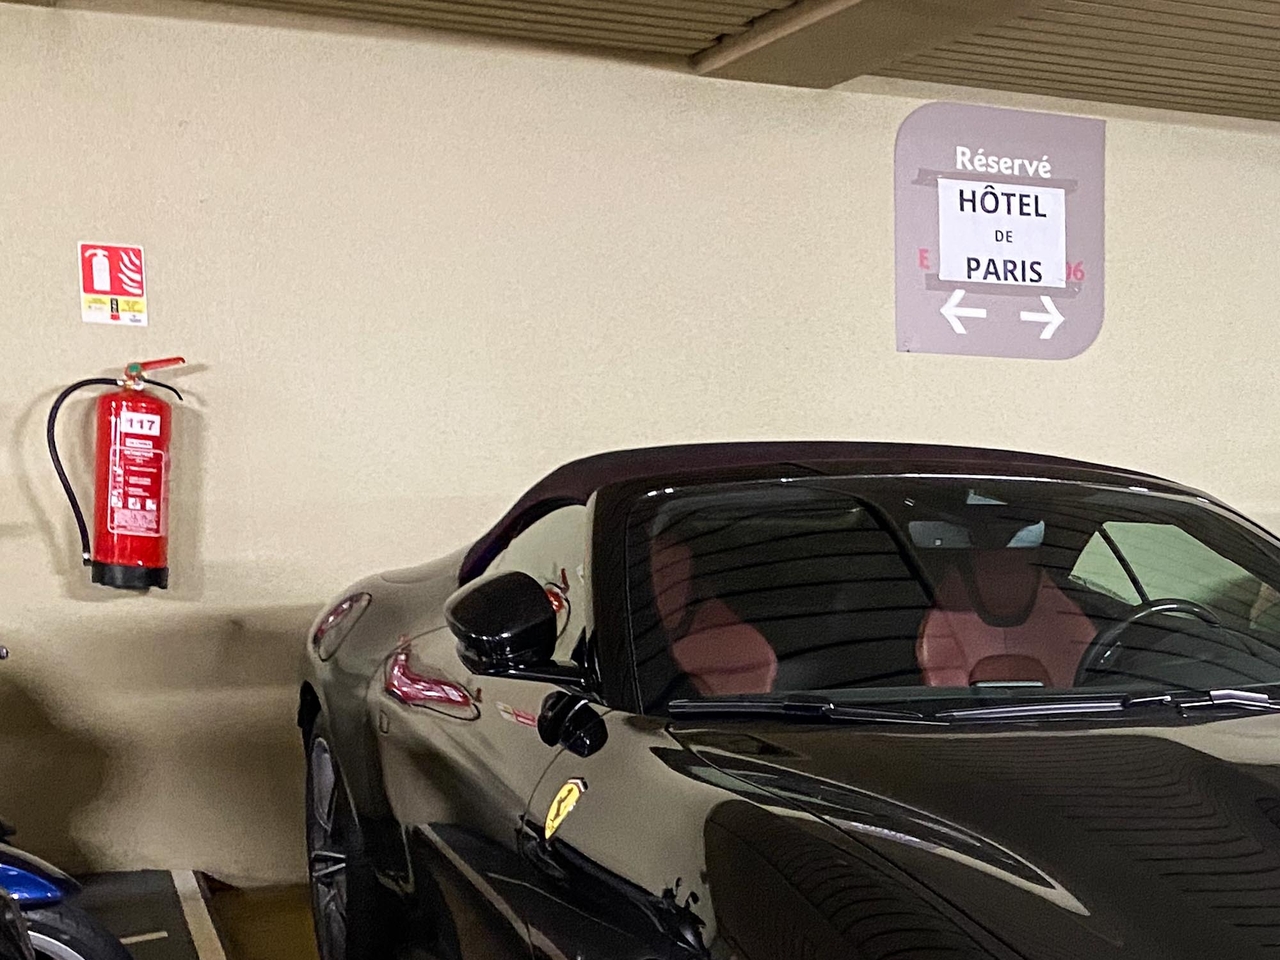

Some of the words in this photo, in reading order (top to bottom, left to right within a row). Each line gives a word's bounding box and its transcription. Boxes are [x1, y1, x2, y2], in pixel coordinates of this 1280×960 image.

[956, 146, 1052, 178] Réservé
[958, 185, 1047, 217] HÔTEL
[994, 230, 1013, 243] DE
[918, 248, 930, 270] E
[966, 257, 1042, 283] PARIS
[126, 418, 155, 431] 117
